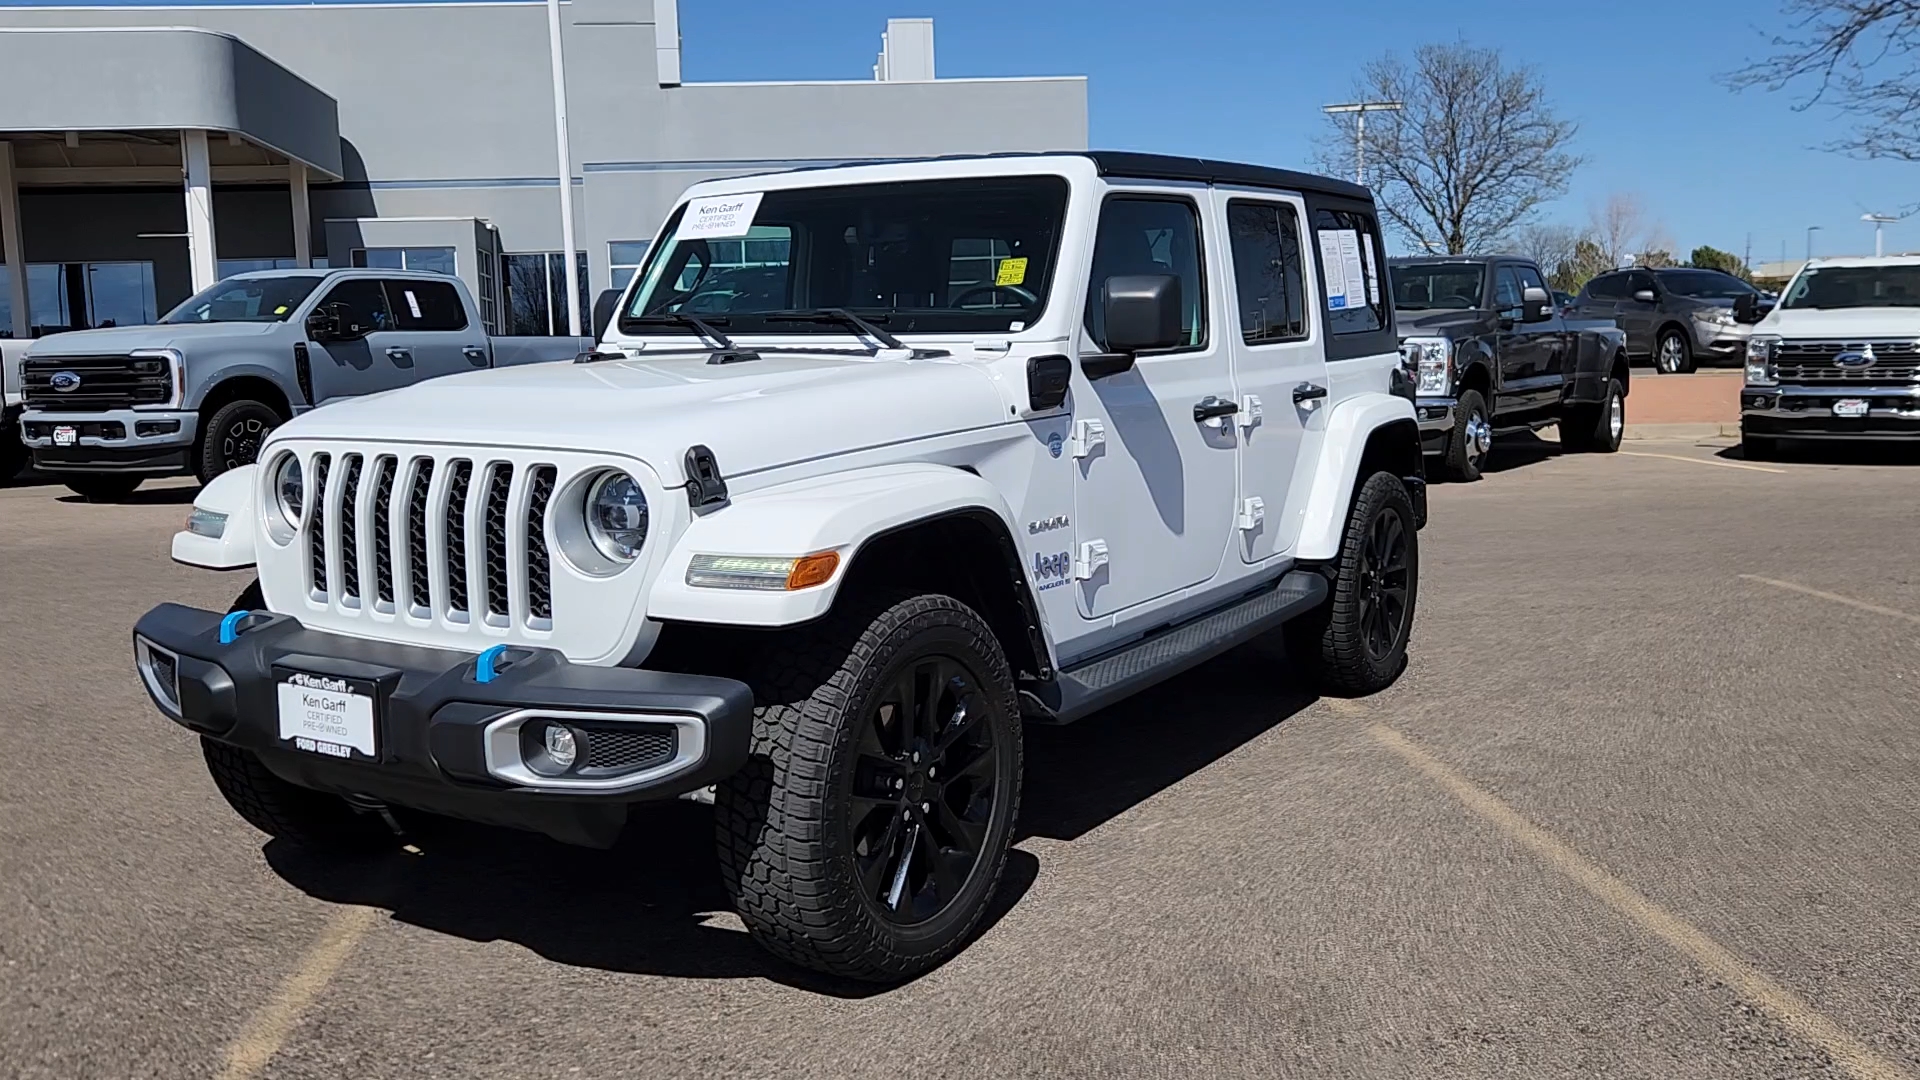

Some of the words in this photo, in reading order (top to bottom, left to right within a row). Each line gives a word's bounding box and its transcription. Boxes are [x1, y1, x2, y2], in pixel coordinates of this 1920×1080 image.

[699, 205, 718, 215] Ken
[719, 202, 744, 213] Garff
[699, 213, 735, 223] CERTIFIED
[1032, 551, 1070, 581] Jeep
[303, 674, 321, 689] Ken
[321, 677, 346, 693] Garff
[302, 693, 320, 709] Ken
[321, 697, 346, 713] Garff
[306, 710, 343, 725] CERTIFIED
[302, 719, 348, 737] PRE-OWNED
